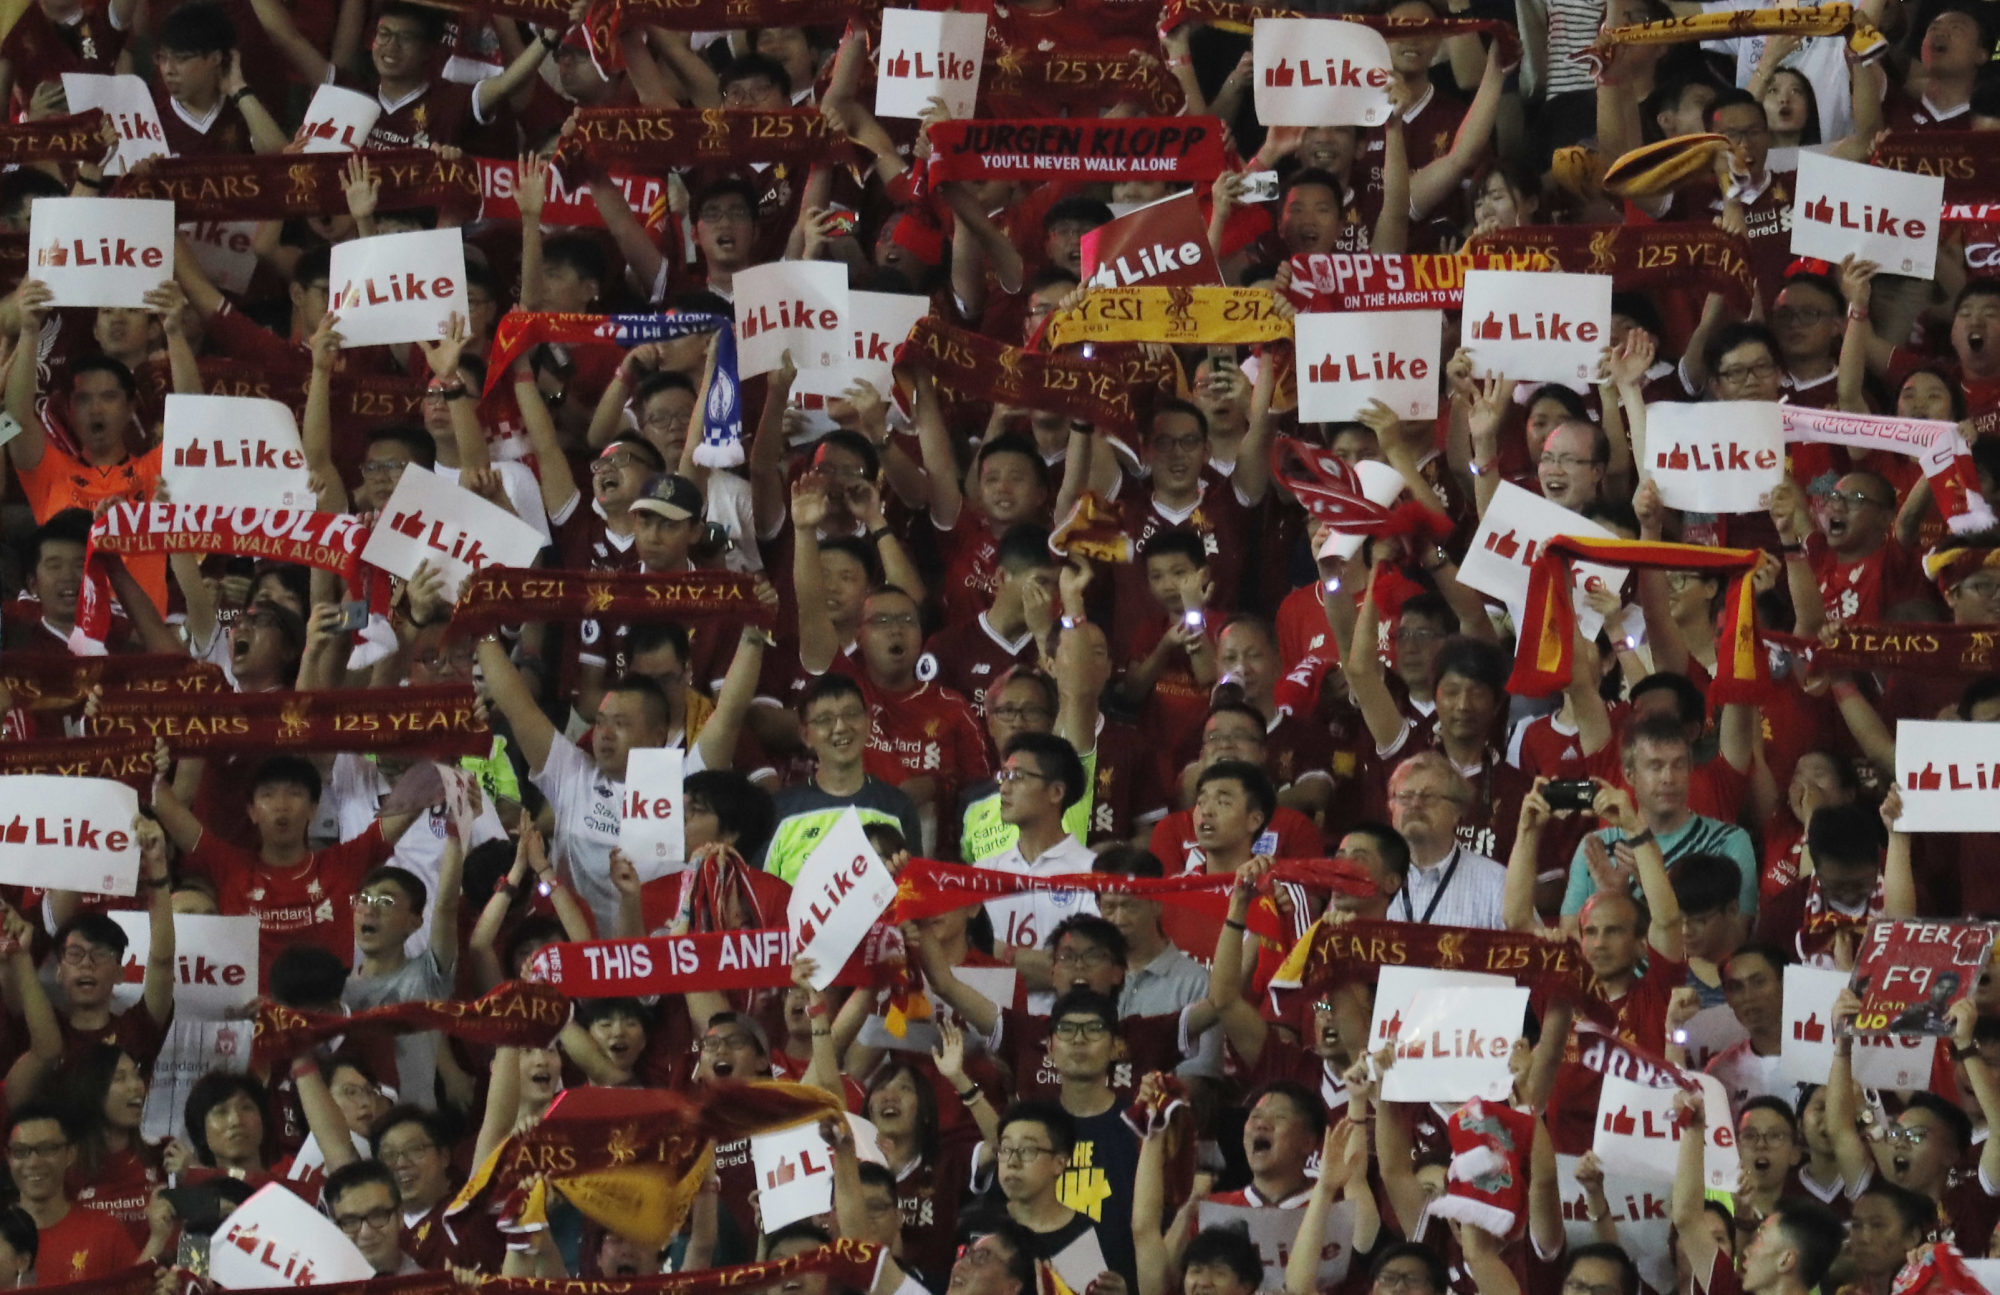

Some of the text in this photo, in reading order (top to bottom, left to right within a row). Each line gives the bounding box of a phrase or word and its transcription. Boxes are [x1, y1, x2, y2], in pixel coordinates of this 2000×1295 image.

[915, 52, 974, 80] Like
[1045, 61, 1088, 82] 125
[1300, 58, 1391, 88] Like
[578, 117, 675, 143] YEARS
[752, 116, 794, 139] 125
[953, 125, 1206, 157] JURGEN KLOPP
[388, 161, 480, 197] YEARS
[981, 155, 1177, 172] YOU'LL NEVER WALK ALONE
[159, 176, 261, 199] YEARS
[484, 165, 514, 199] IS
[1839, 201, 1927, 239] Like
[74, 238, 164, 268] Like
[1116, 241, 1202, 286] Like
[1637, 246, 1679, 269] 125
[364, 272, 456, 306] Like
[1344, 296, 1361, 309] ON
[1363, 293, 1386, 307] THE
[1387, 291, 1429, 306] MARCH
[1431, 291, 1448, 303] TO
[760, 300, 838, 332] Like
[1510, 311, 1599, 342] Like
[908, 325, 976, 369] EARS
[1043, 368, 1079, 391] 125
[1345, 351, 1429, 382] Like
[213, 439, 304, 469] Like
[1694, 441, 1777, 471] Like
[91, 500, 368, 554] LIVERPOOL FC
[163, 533, 222, 552] NEVER
[232, 536, 283, 556] WALK
[290, 544, 350, 571] ALONE
[427, 519, 506, 570] Lik
[144, 717, 250, 737] YEARS
[334, 707, 489, 734] 125 YEARS
[36, 816, 129, 853] Like
[809, 853, 869, 926] Like
[1006, 910, 1038, 951] 16
[583, 930, 793, 981] THIS IS ANFI
[1316, 935, 1407, 966] YEARS
[1486, 946, 1530, 970] 125
[178, 955, 246, 986] ike
[1432, 1028, 1509, 1059] Like
[260, 1240, 317, 1289] Lik
